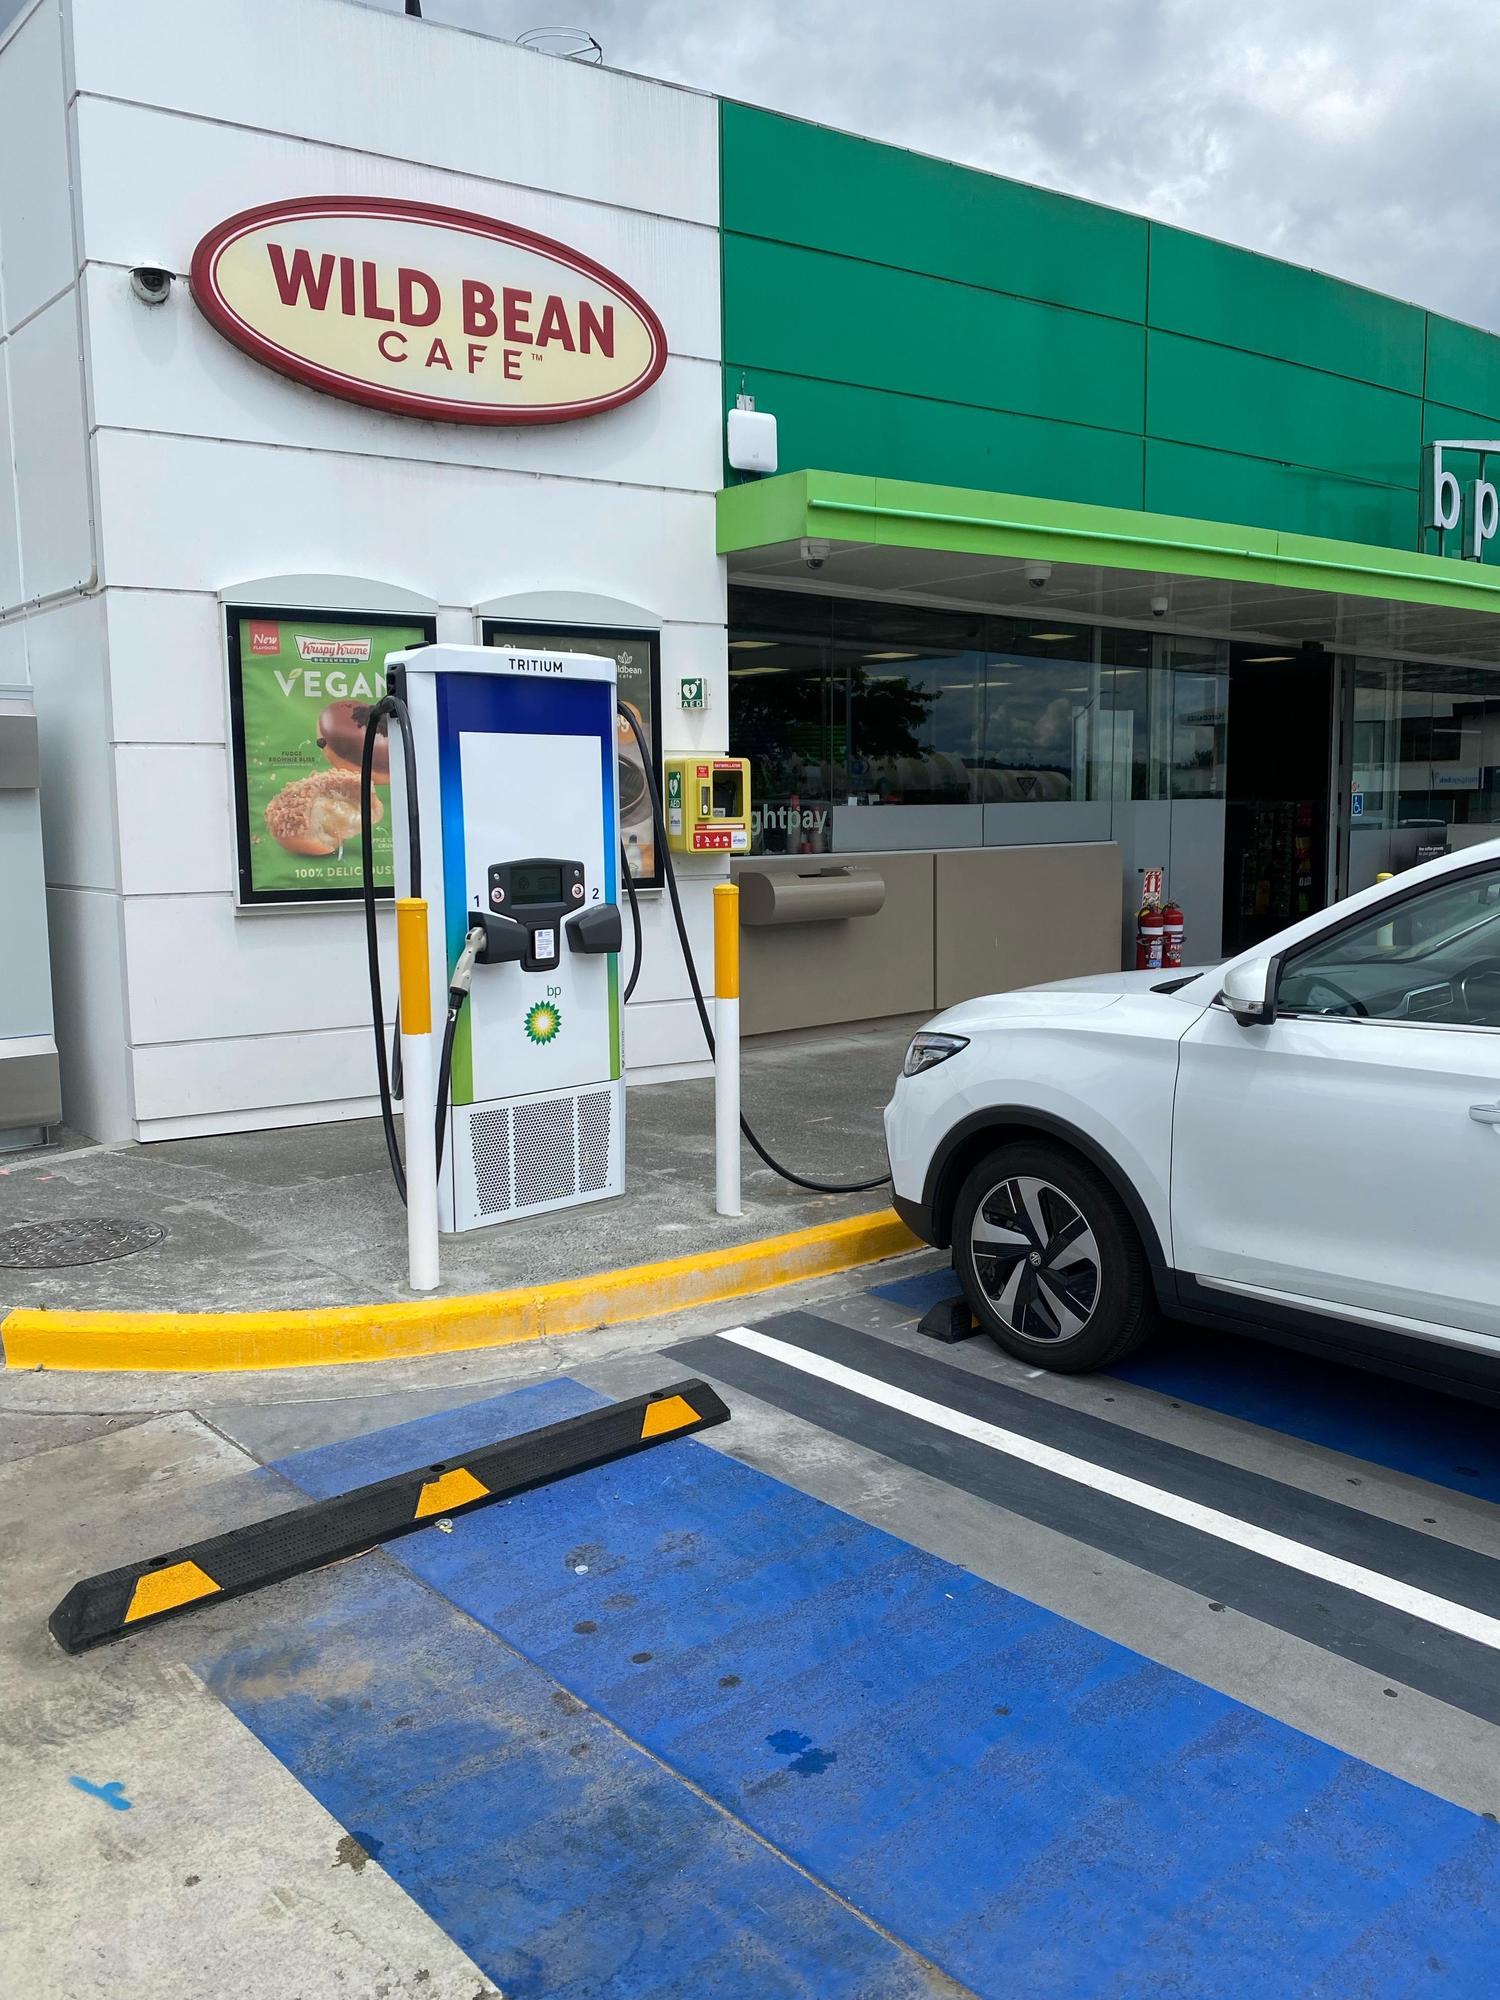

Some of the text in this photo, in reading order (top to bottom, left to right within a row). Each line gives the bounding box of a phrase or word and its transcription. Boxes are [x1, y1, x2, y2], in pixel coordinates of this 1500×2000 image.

[266, 243, 615, 358] WILD BEAN
[378, 330, 523, 381] CAFE
[253, 634, 278, 645] New
[302, 640, 369, 657] Krispy Kreme
[508, 658, 563, 673] TRITIUM
[274, 668, 387, 698] VEGAN
[751, 803, 828, 835] ghtpay
[295, 865, 323, 878] 100%
[474, 895, 480, 907] 1
[592, 888, 599, 899] 2
[546, 985, 562, 997] bp
